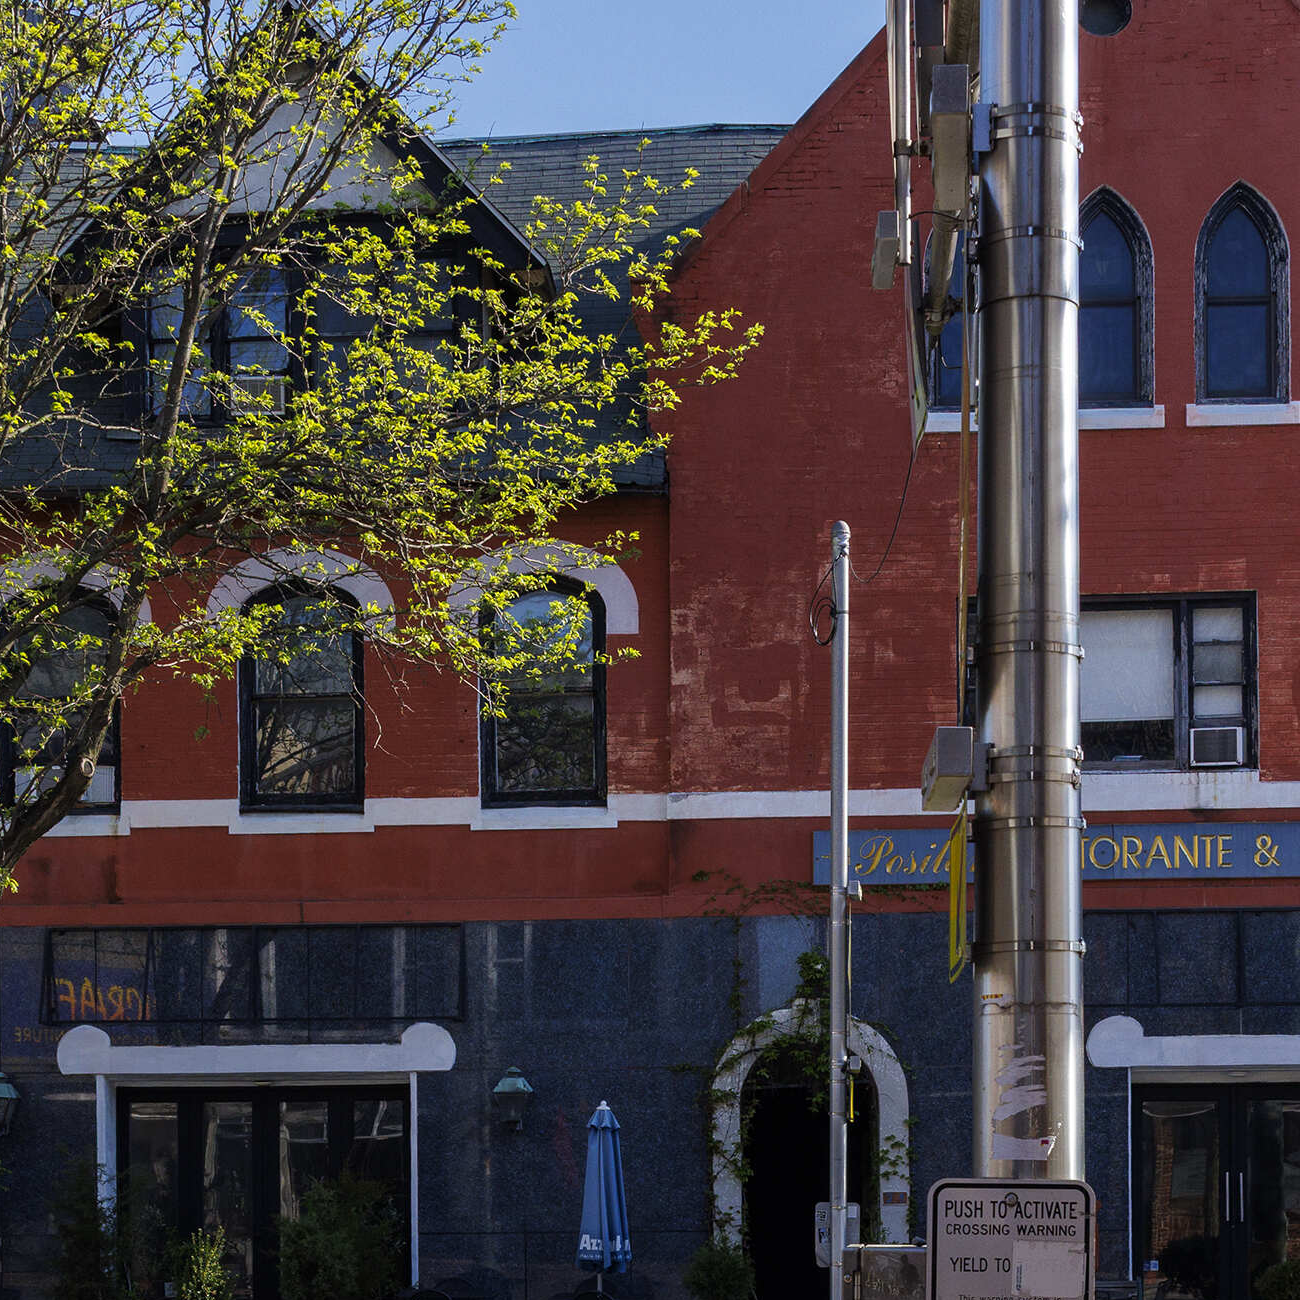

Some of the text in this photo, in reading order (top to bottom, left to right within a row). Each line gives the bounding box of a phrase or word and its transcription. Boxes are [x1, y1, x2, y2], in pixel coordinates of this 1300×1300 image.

[1079, 833, 1233, 869] TORANTE
[1254, 834, 1280, 867] &
[945, 1200, 1078, 1219] PUSH TO ACTIVATE
[946, 1223, 1076, 1236] CROSSING WARNING
[950, 1257, 1011, 1272] YIELD TO
